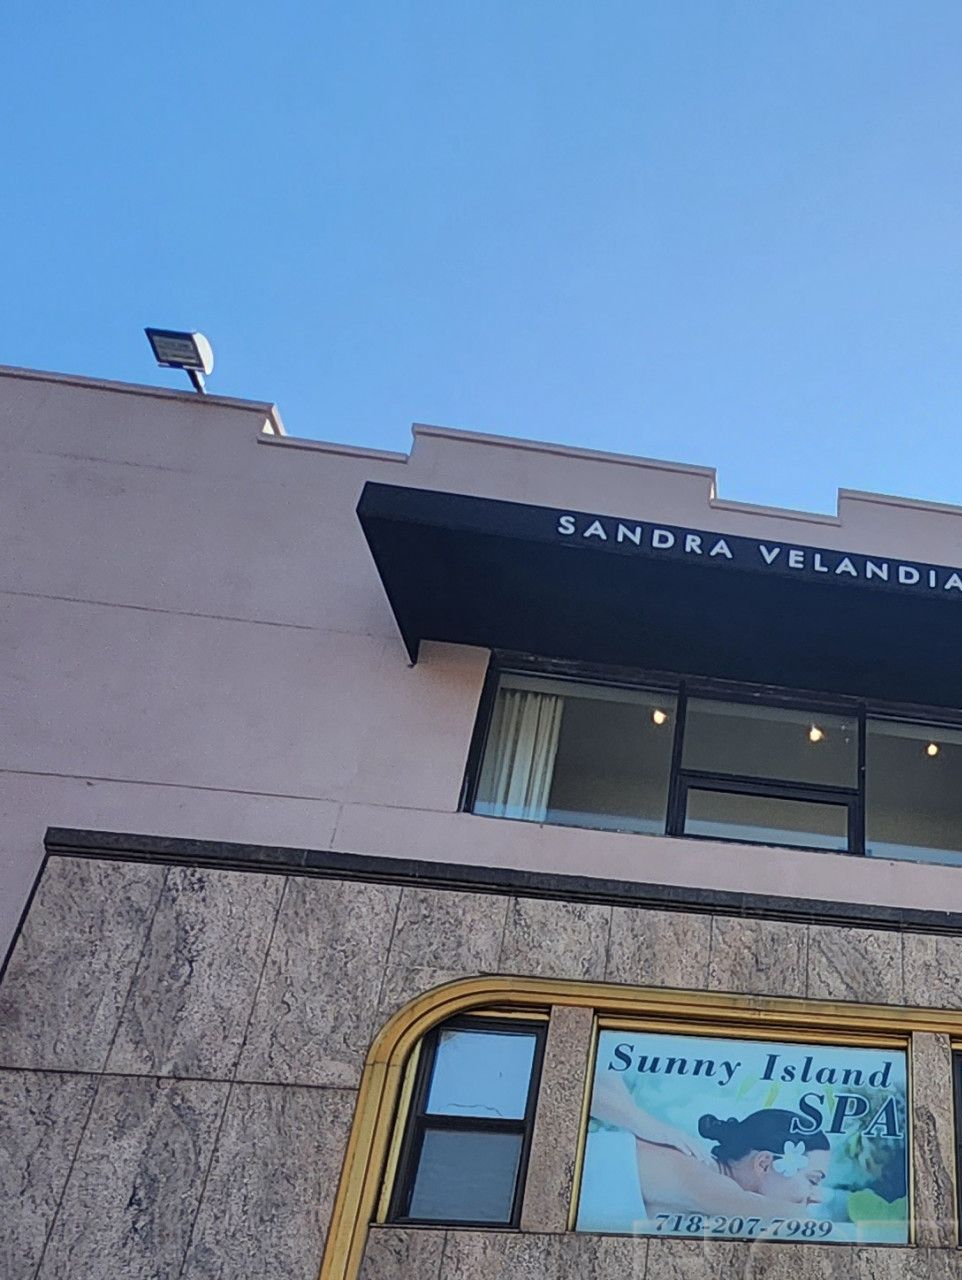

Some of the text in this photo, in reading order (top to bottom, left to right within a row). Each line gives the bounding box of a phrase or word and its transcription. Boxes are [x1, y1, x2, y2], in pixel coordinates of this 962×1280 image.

[557, 515, 733, 560] SANDRA
[608, 1043, 892, 1089] Sunny Island
[790, 1092, 904, 1138] SPA
[654, 1213, 833, 1238] 718-207-7989
